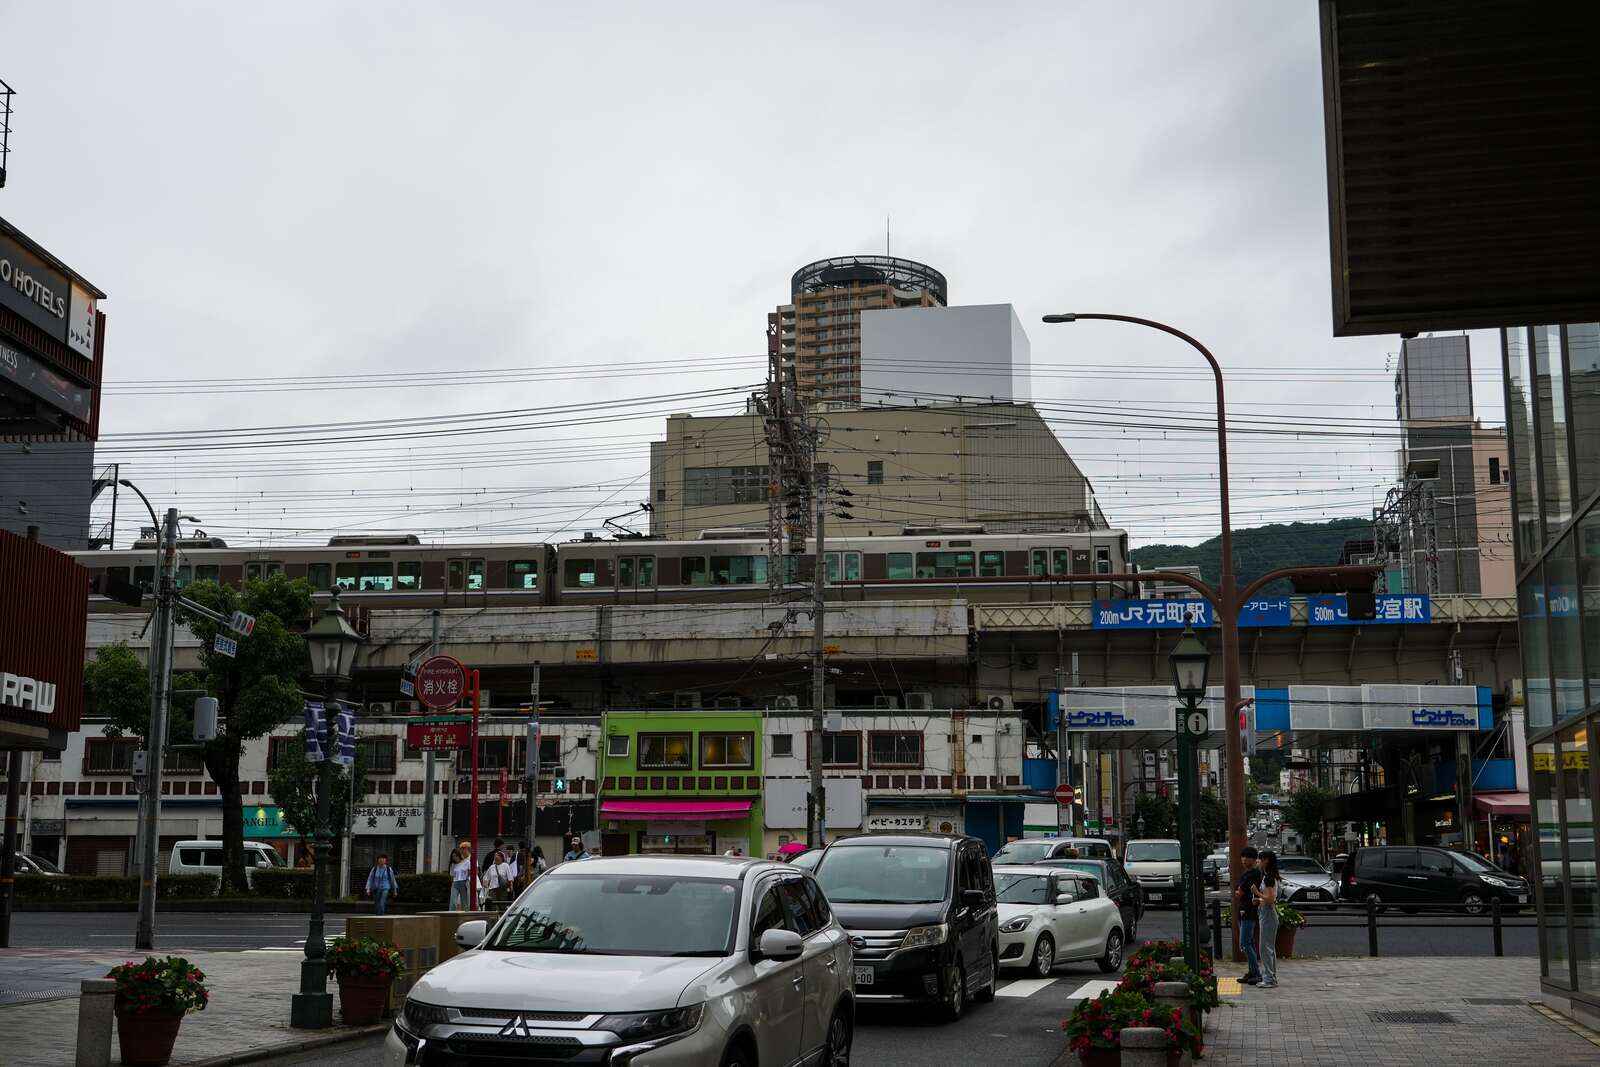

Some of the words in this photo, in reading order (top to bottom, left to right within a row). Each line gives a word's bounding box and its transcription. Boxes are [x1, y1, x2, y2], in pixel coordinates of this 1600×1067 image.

[14, 267, 65, 319] HOTELS
[1100, 610, 1119, 625] 200m
[1120, 607, 1143, 621] JR
[1314, 607, 1334, 621] 500m
[0, 672, 56, 713] RAW
[423, 679, 458, 695] 消火栓
[870, 818, 922, 827] ベビーカステラ
